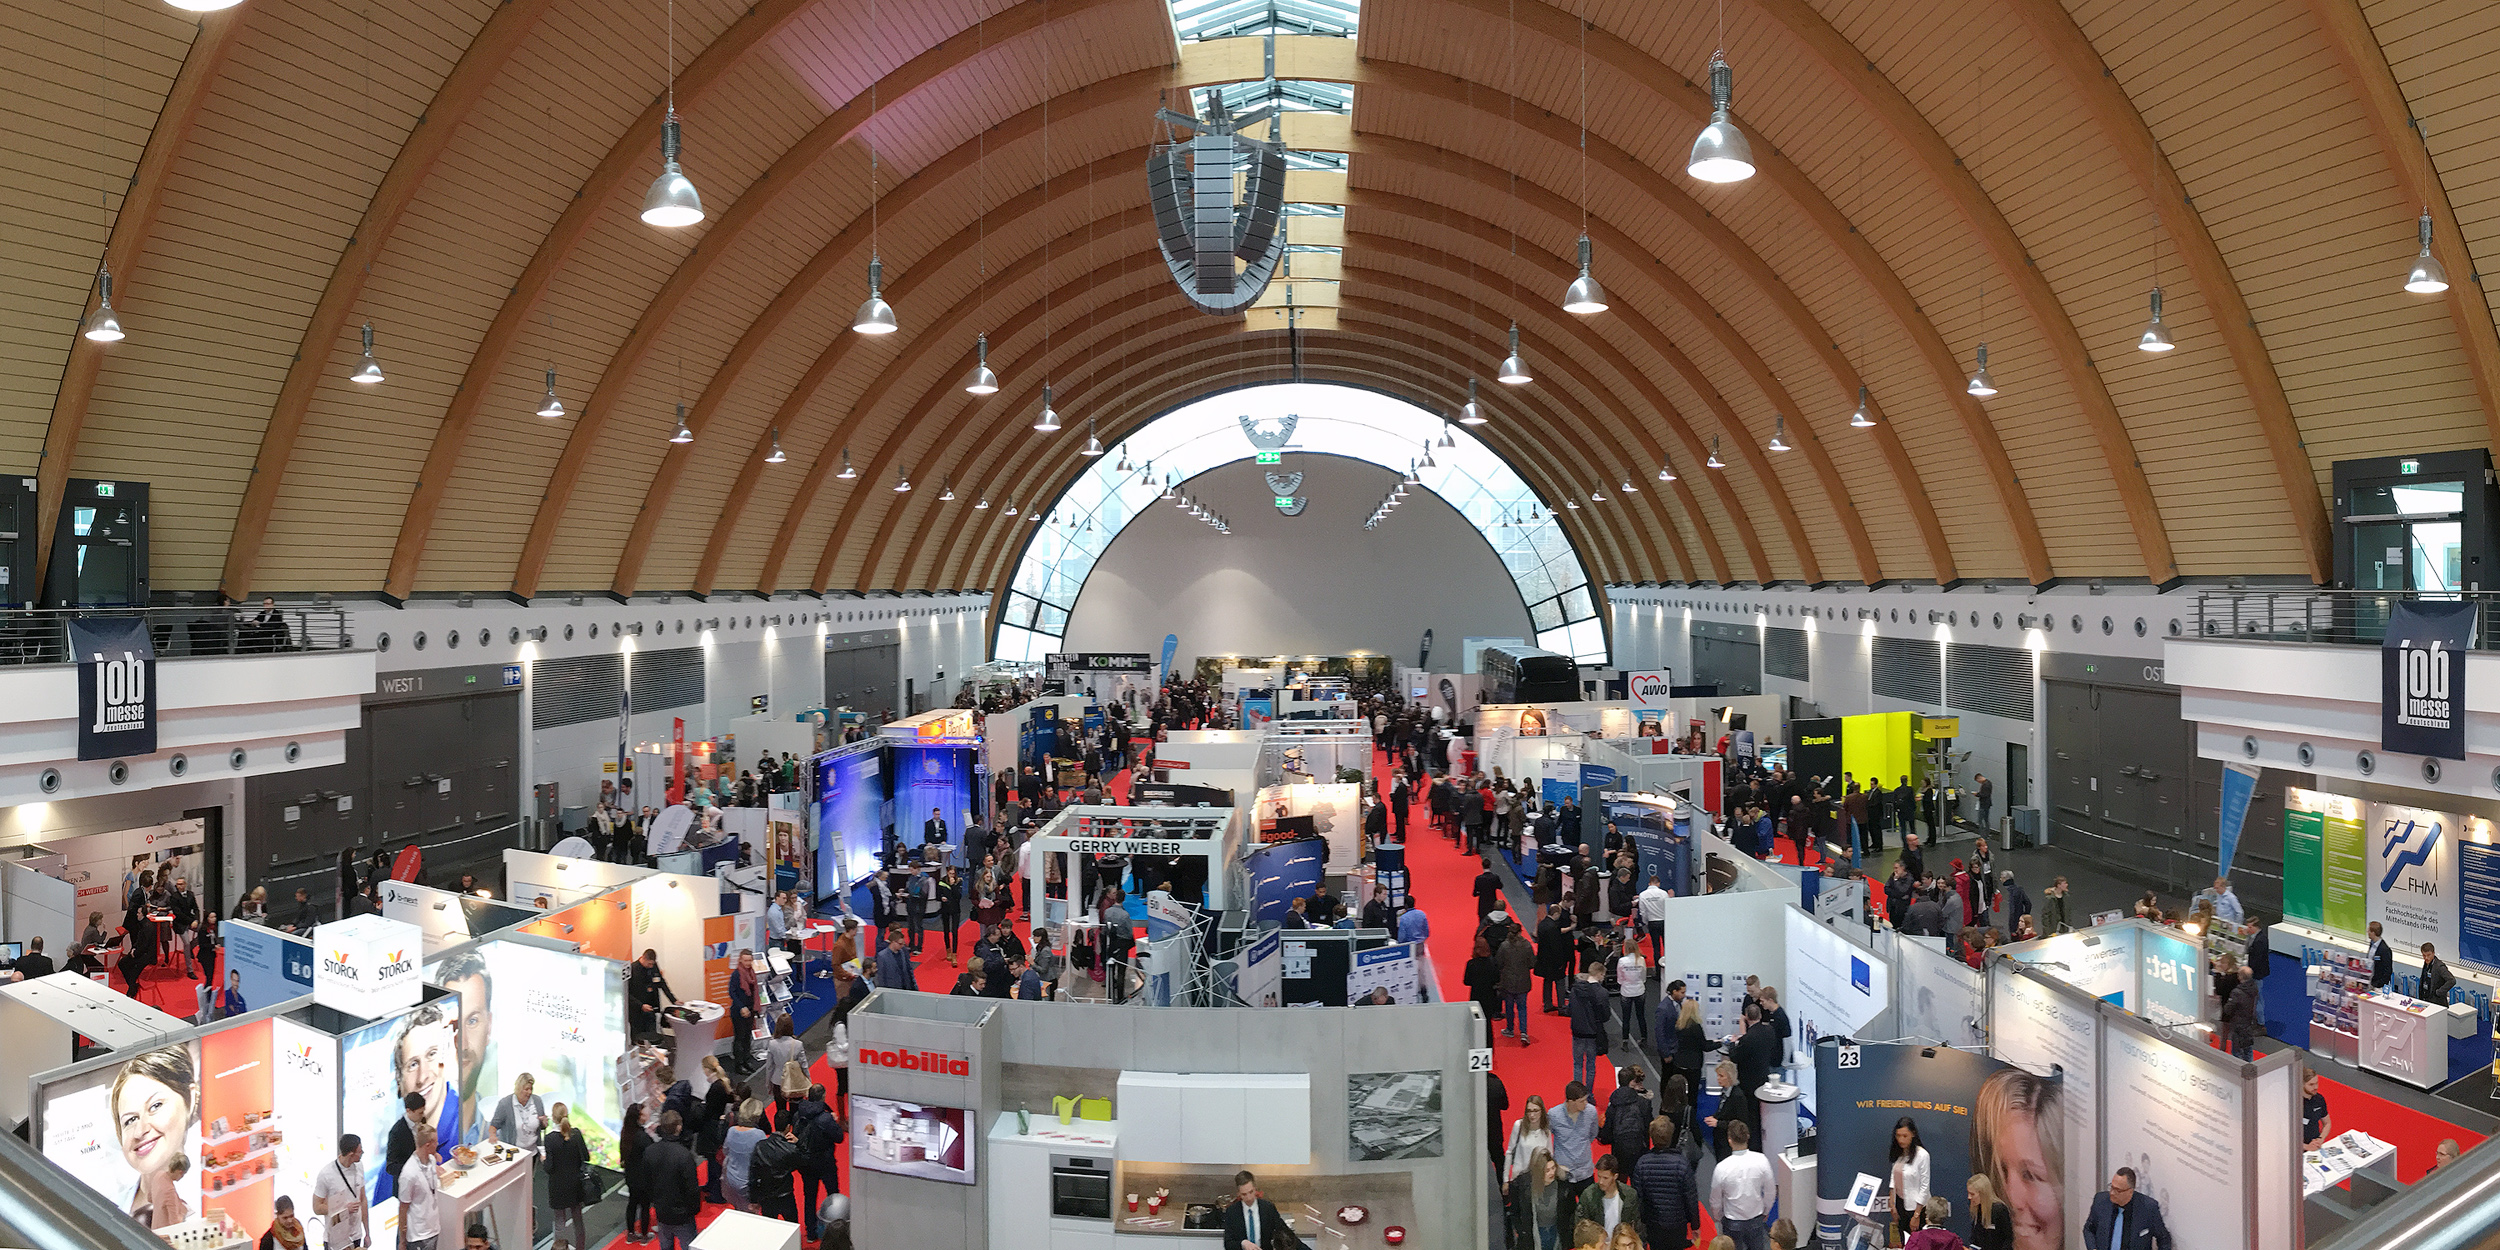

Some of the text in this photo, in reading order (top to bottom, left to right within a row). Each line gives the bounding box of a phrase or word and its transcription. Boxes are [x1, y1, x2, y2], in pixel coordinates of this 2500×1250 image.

[382, 677, 423, 693] WEST 1
[1641, 684, 1668, 696] AWO
[2397, 639, 2450, 725] job
[93, 651, 145, 733] job
[106, 704, 145, 723] messe
[2409, 699, 2450, 719] messe
[105, 721, 145, 733] deutschland
[2408, 718, 2450, 729] deutschland
[1801, 734, 1834, 746] Brunel
[1069, 840, 1180, 854] GERRY WEBER
[2408, 876, 2438, 897] FHM
[2385, 915, 2439, 933] Mittelstands (FHM)
[2386, 906, 2439, 924] Fachhochschule des
[324, 958, 359, 981] STORCK
[378, 959, 413, 981] STORCK
[859, 1048, 970, 1077] nobilia
[1471, 1054, 1491, 1070] 24
[1839, 1051, 1859, 1067] 23
[1856, 1100, 1874, 1108] WIR
[1876, 1099, 1911, 1108] FREUEN
[1912, 1101, 1932, 1110] UNS
[1934, 1103, 1951, 1112] AUF
